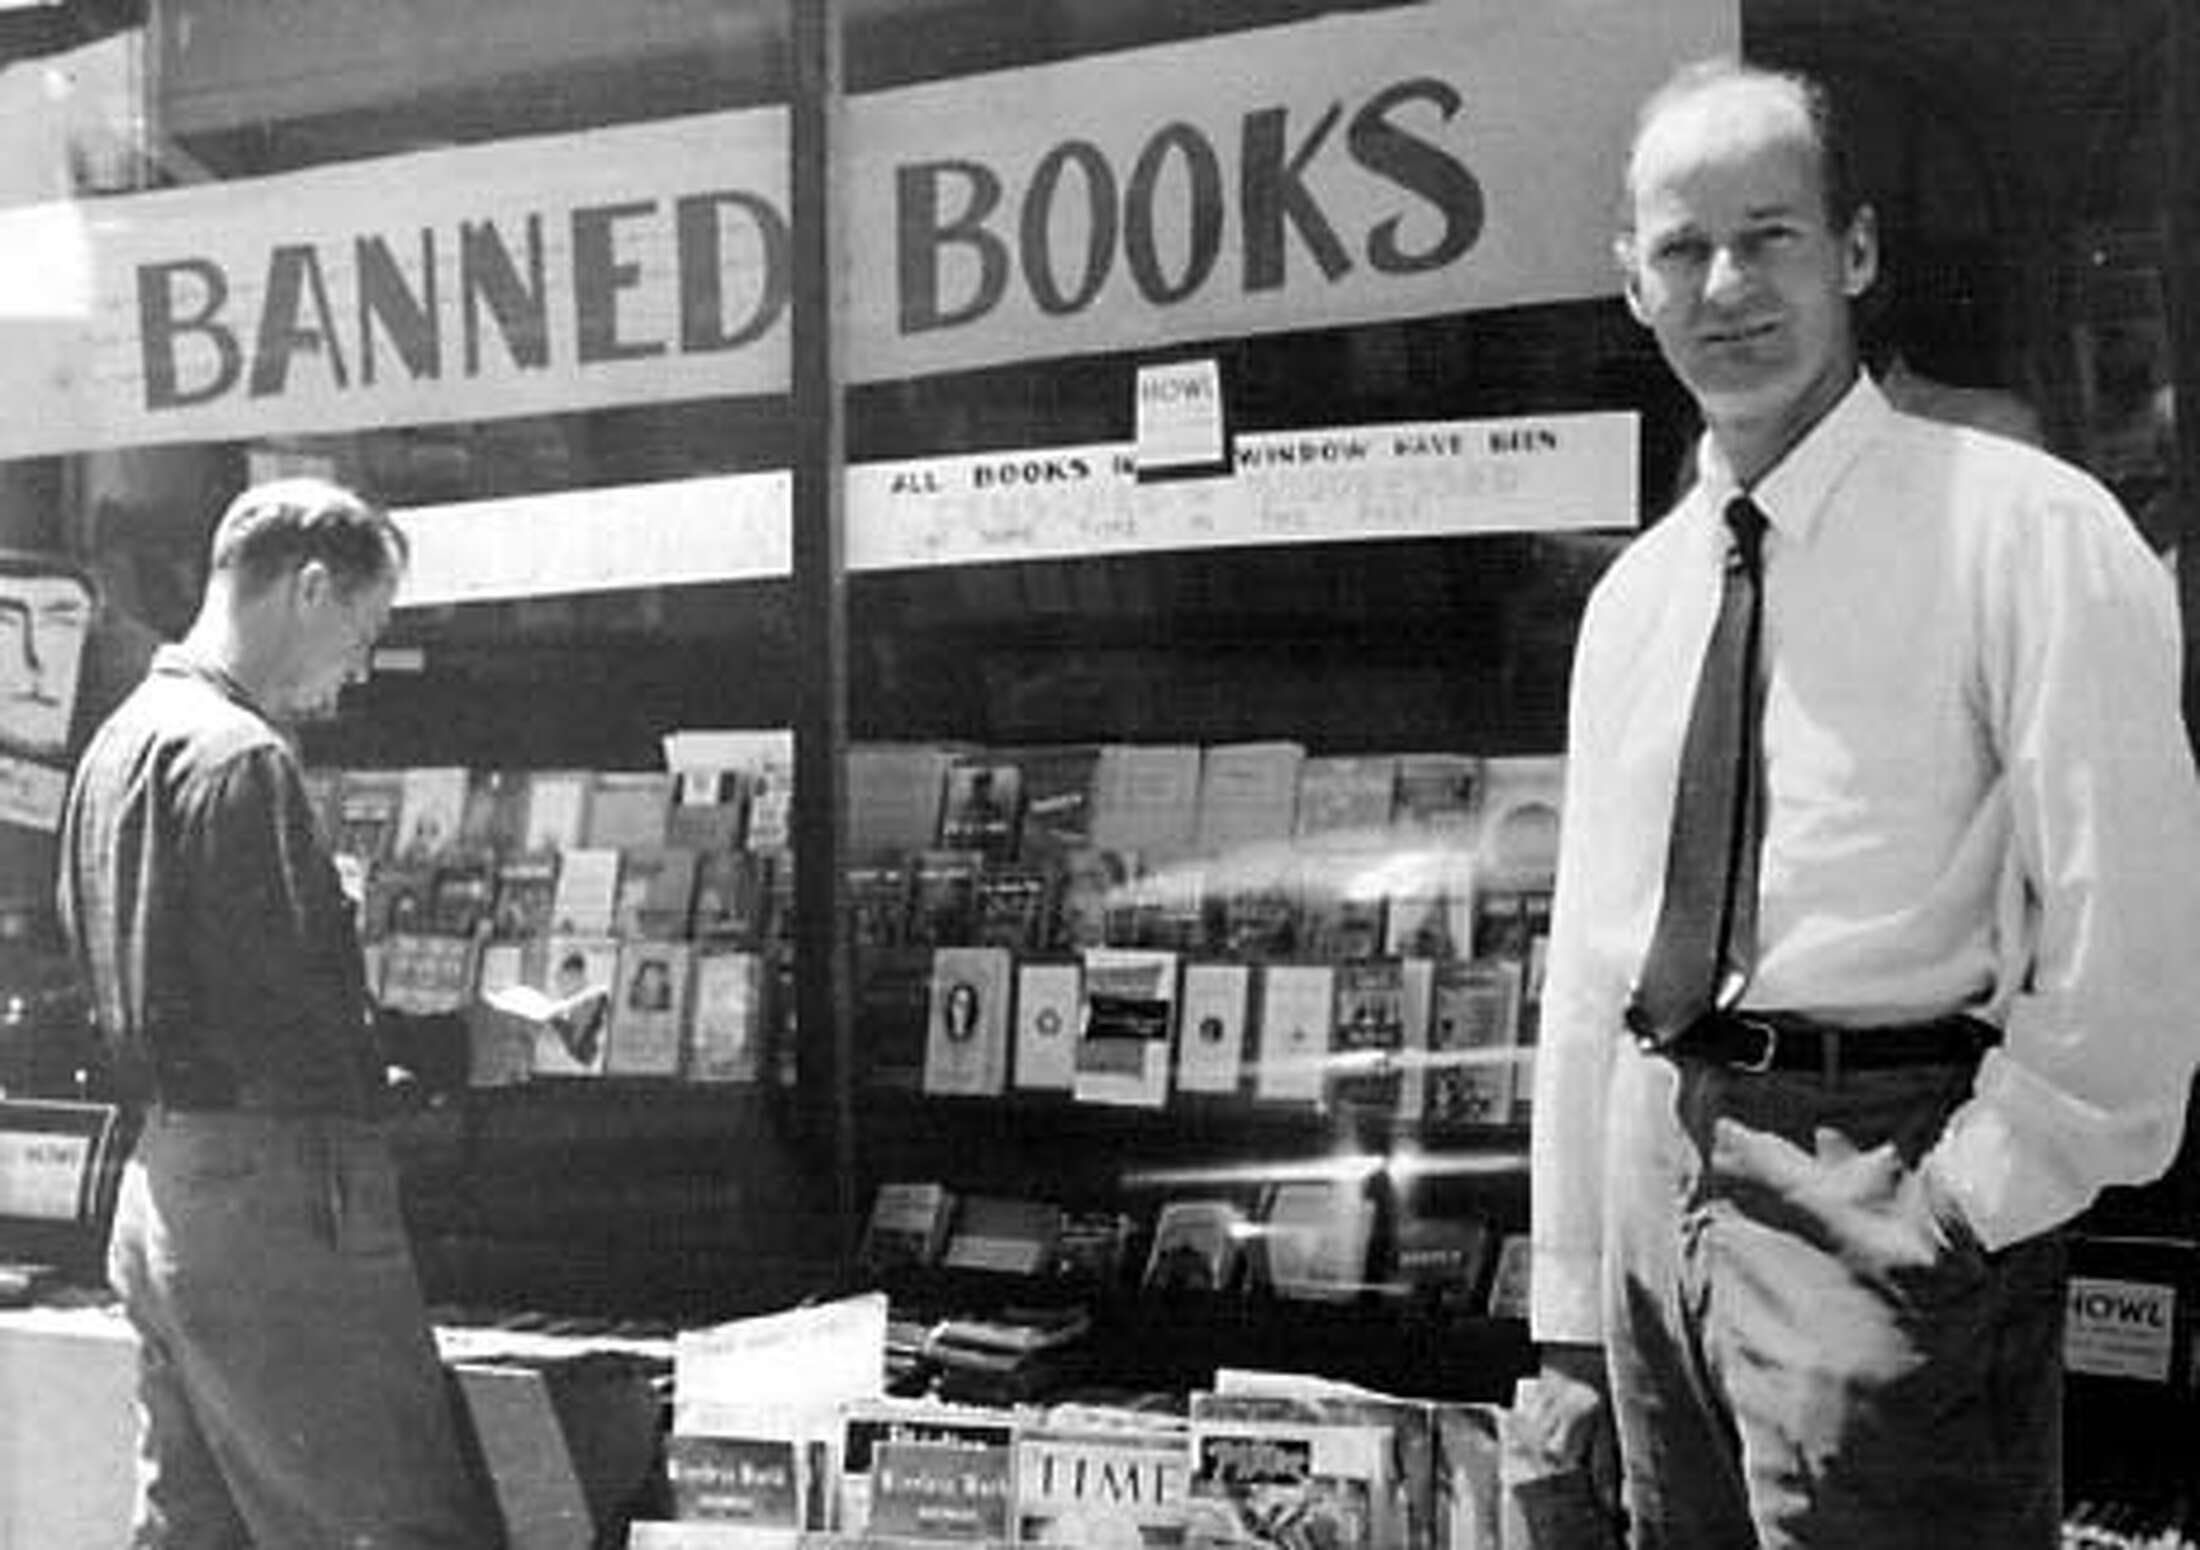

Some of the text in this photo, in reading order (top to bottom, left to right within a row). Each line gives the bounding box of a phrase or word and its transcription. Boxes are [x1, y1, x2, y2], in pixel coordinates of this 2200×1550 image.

[136, 77, 1486, 413] BANNED BOOKS
[891, 470, 936, 493] ALL
[973, 458, 1090, 488] BOOKS
[1234, 437, 1366, 467] WINDOW
[1394, 433, 1461, 456] HAVE
[1489, 428, 1558, 454] BEEN
[1036, 1454, 1180, 1506] TIME
